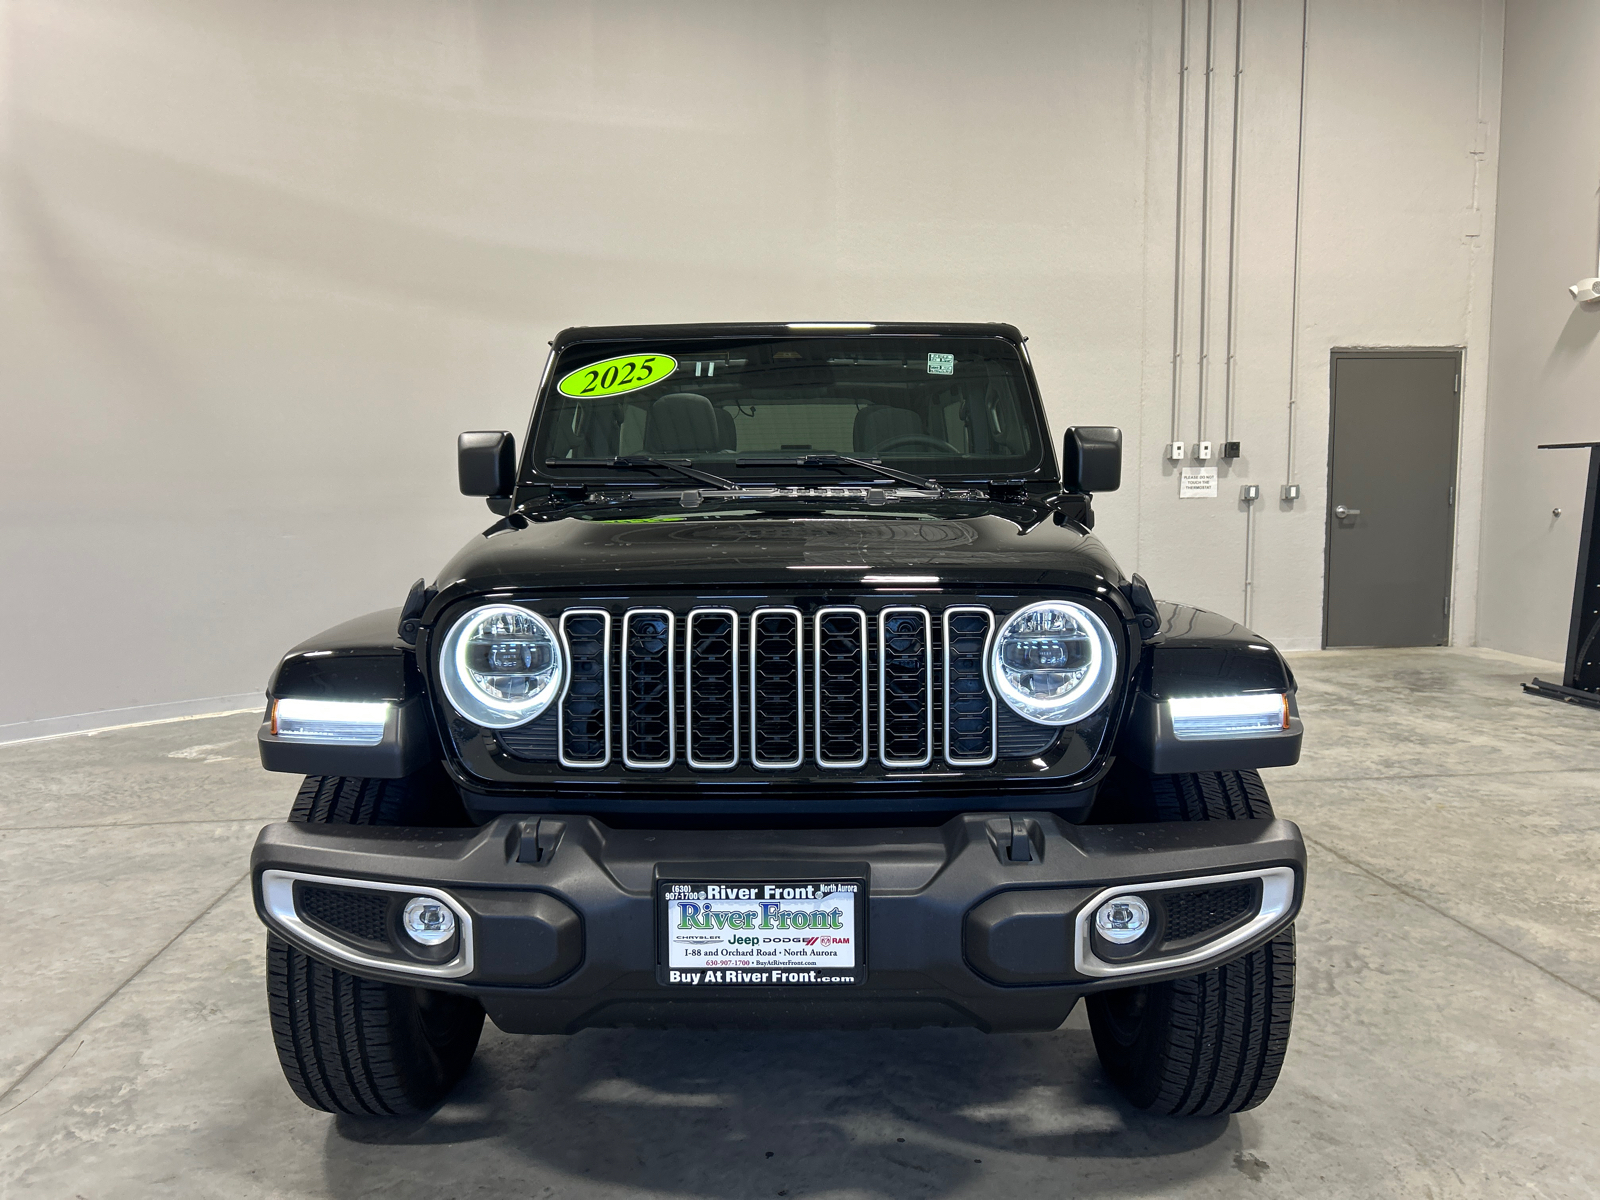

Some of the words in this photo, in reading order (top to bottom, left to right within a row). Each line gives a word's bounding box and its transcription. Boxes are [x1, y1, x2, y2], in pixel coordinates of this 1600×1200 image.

[579, 357, 656, 394] 2025
[671, 885, 691, 893] (630)
[707, 885, 758, 900] River
[764, 885, 814, 899] Front
[820, 884, 836, 893] North
[838, 884, 857, 893] Aurora
[665, 892, 698, 900] 907-1700
[728, 934, 759, 946] Jeep
[684, 948, 702, 957] I-88
[703, 948, 719, 957] and
[720, 948, 754, 957] Orchard
[756, 948, 777, 957] Road
[783, 948, 808, 957] North
[809, 948, 838, 957] Aurora
[755, 959, 817, 967] BuyAtRiverFront.com
[669, 970, 701, 985] Buy
[704, 970, 723, 983] At
[725, 970, 769, 983] River
